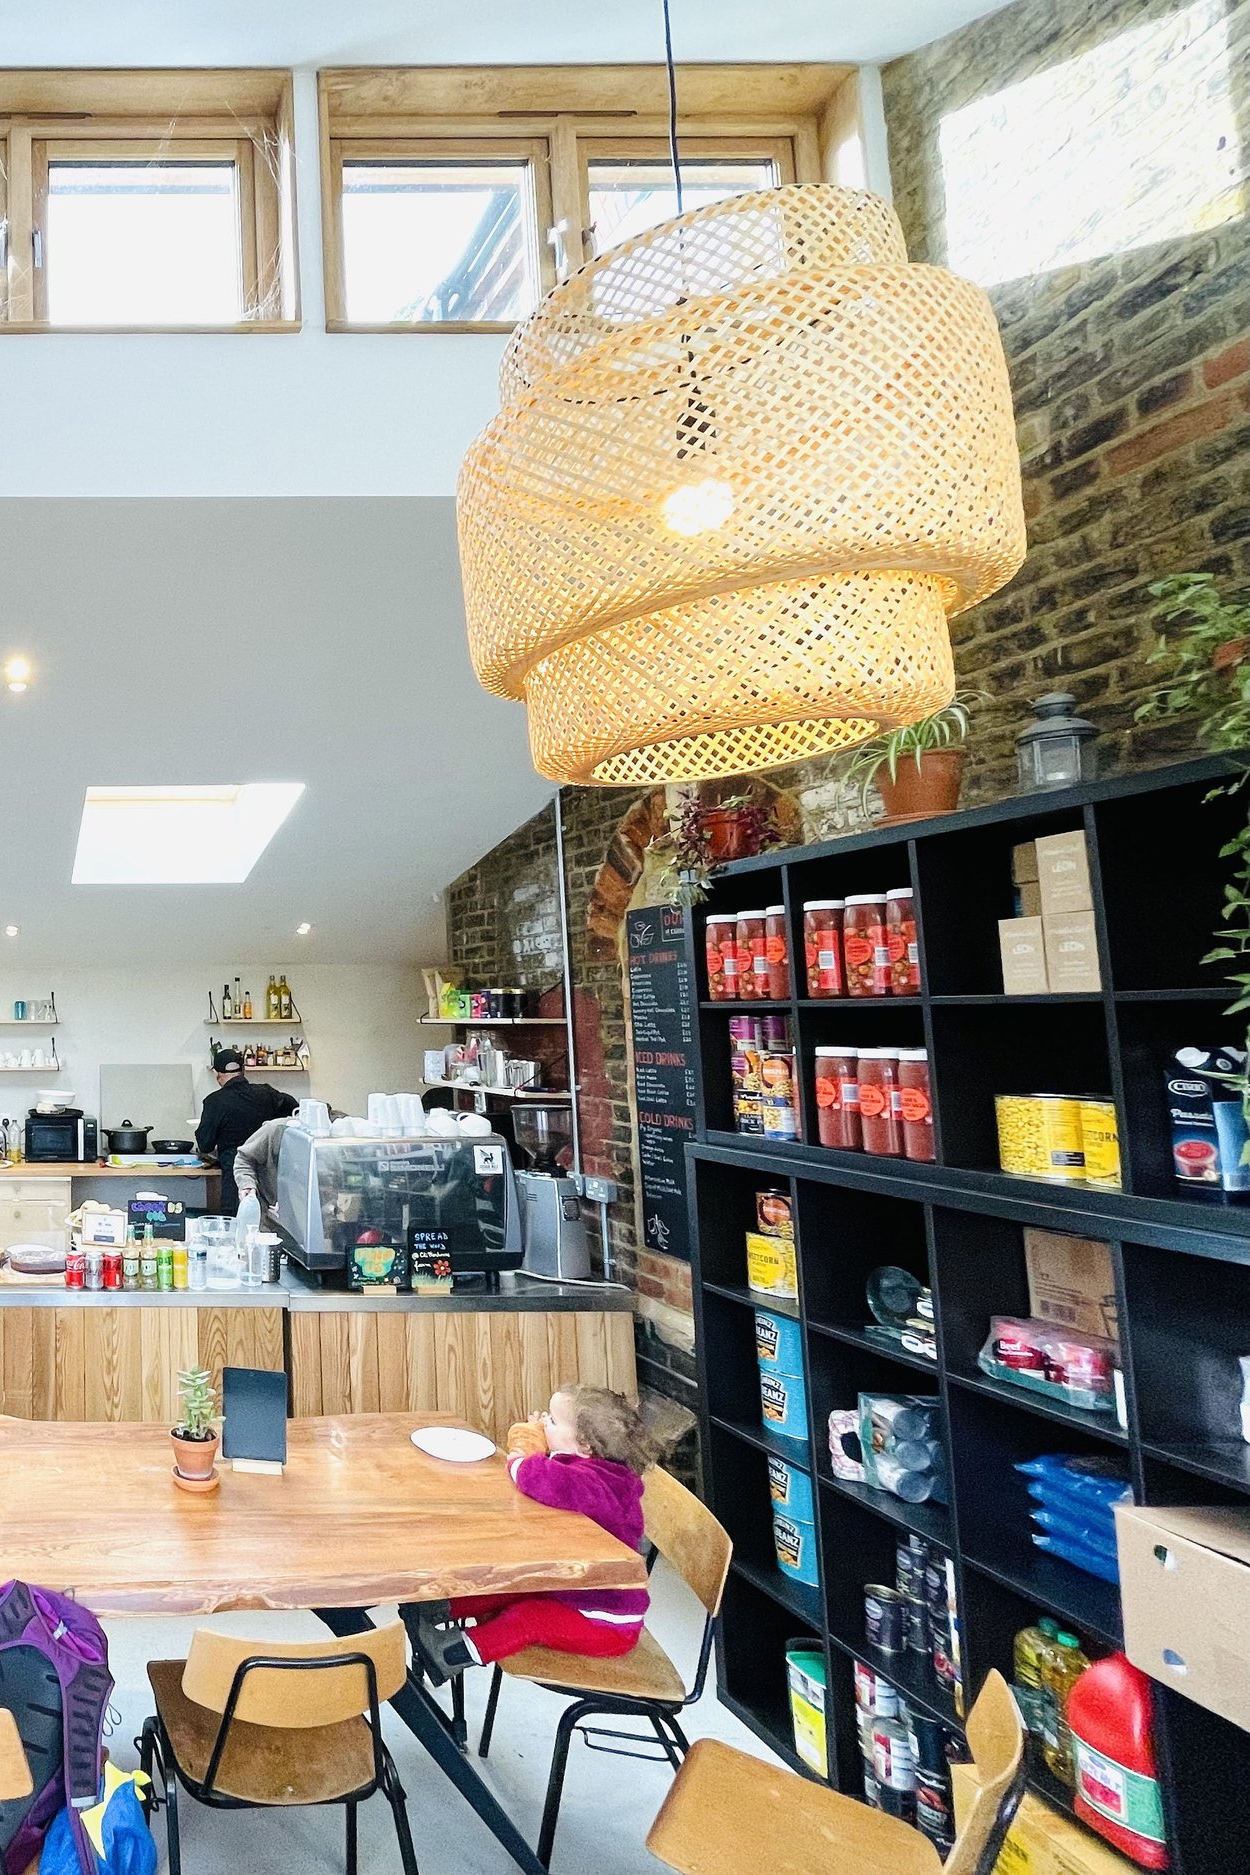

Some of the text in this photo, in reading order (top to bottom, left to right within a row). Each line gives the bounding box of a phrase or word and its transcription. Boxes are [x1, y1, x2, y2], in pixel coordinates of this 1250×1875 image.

[655, 1052, 686, 1067] DRINKS
[639, 1111, 662, 1126] COLD
[663, 1114, 694, 1131] DRINKS
[414, 1232, 449, 1241] SPREAD
[1000, 1341, 1021, 1351] Beef
